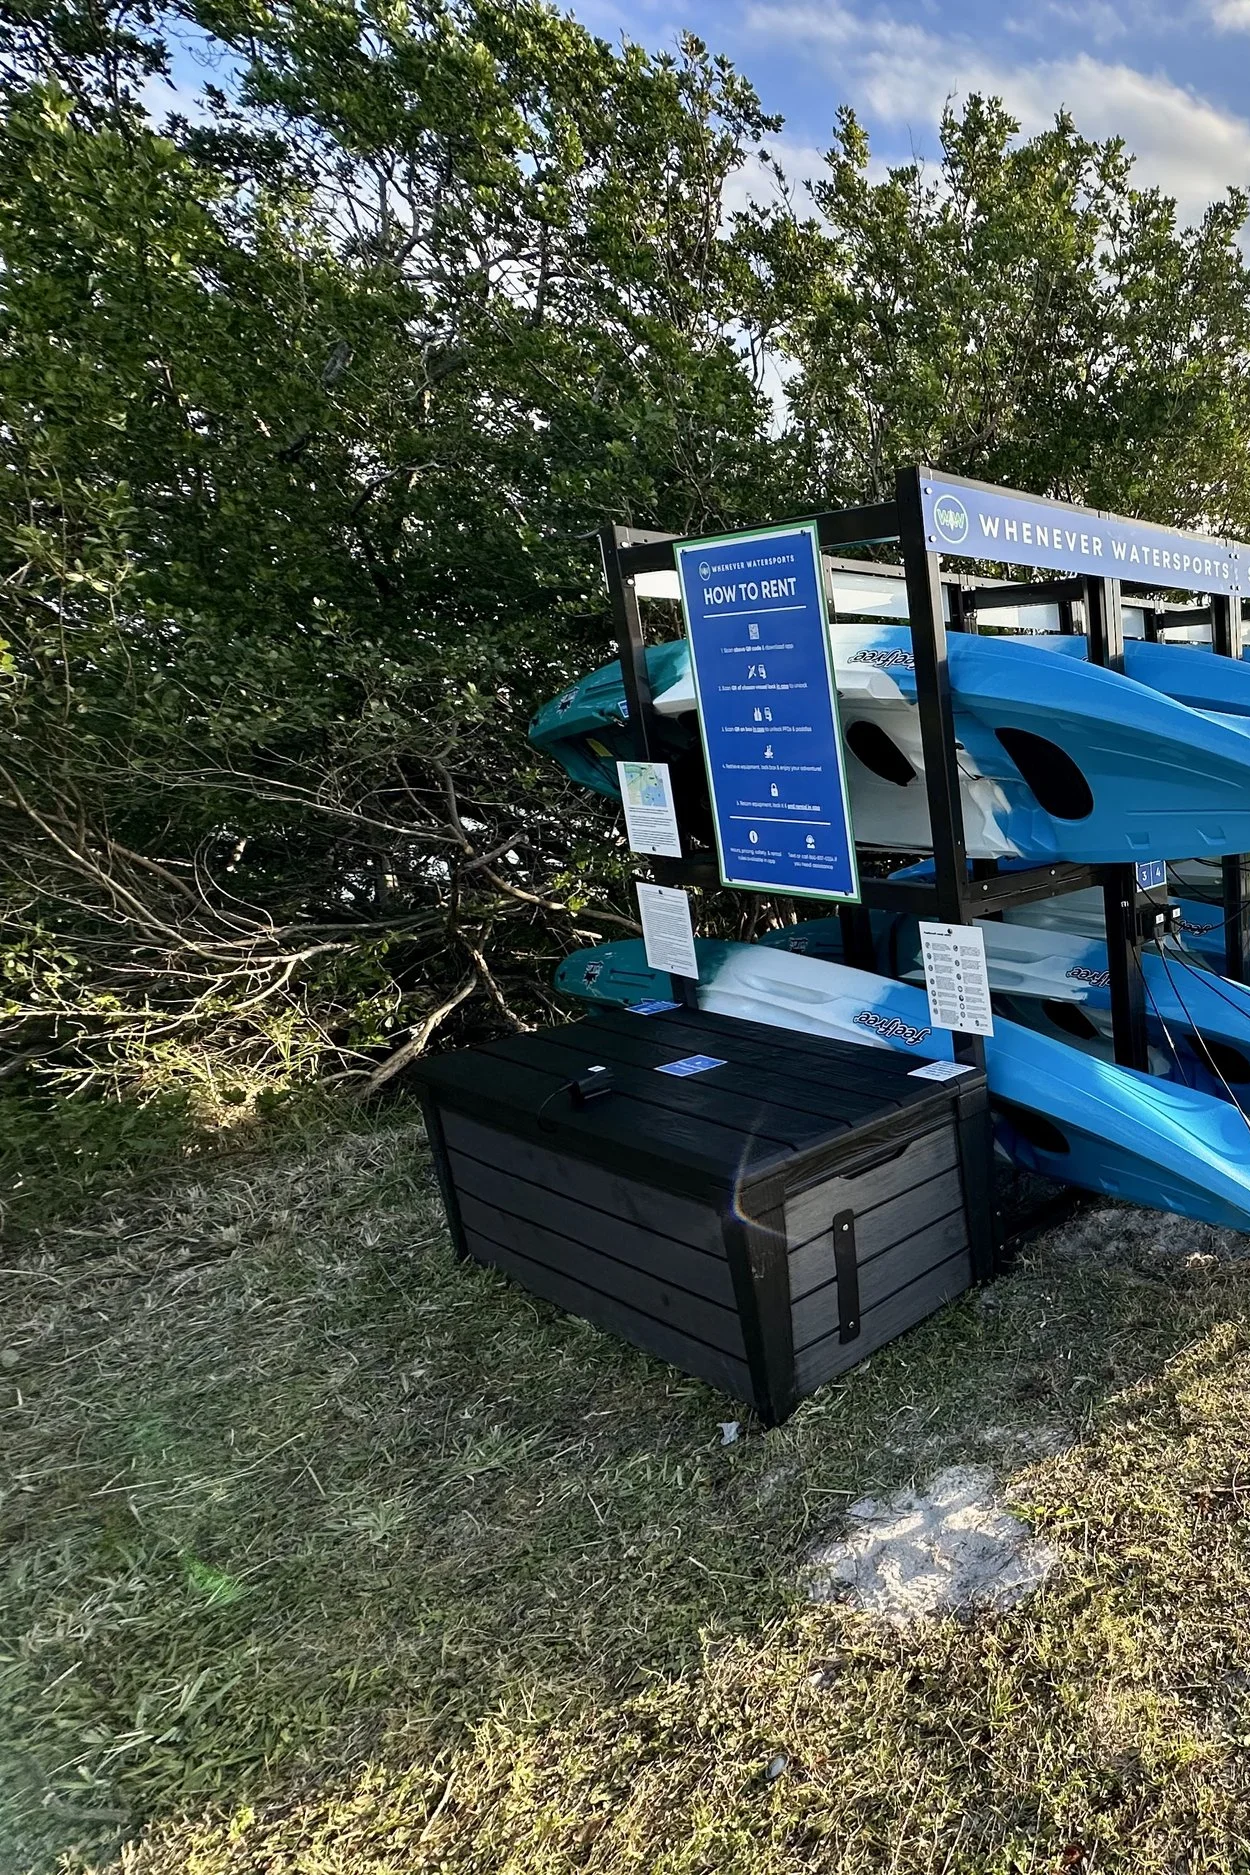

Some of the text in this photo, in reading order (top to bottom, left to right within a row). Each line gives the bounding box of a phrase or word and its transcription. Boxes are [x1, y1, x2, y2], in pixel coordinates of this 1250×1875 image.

[978, 513, 1230, 580] WHENEVER WATERSPORTS
[711, 554, 795, 573] WHENEVER WATERSPORTS
[703, 577, 797, 605] HOW TO RENT
[847, 648, 915, 671] eelfree
[1142, 866, 1161, 881] 3 4
[852, 1010, 932, 1046] feelfree
